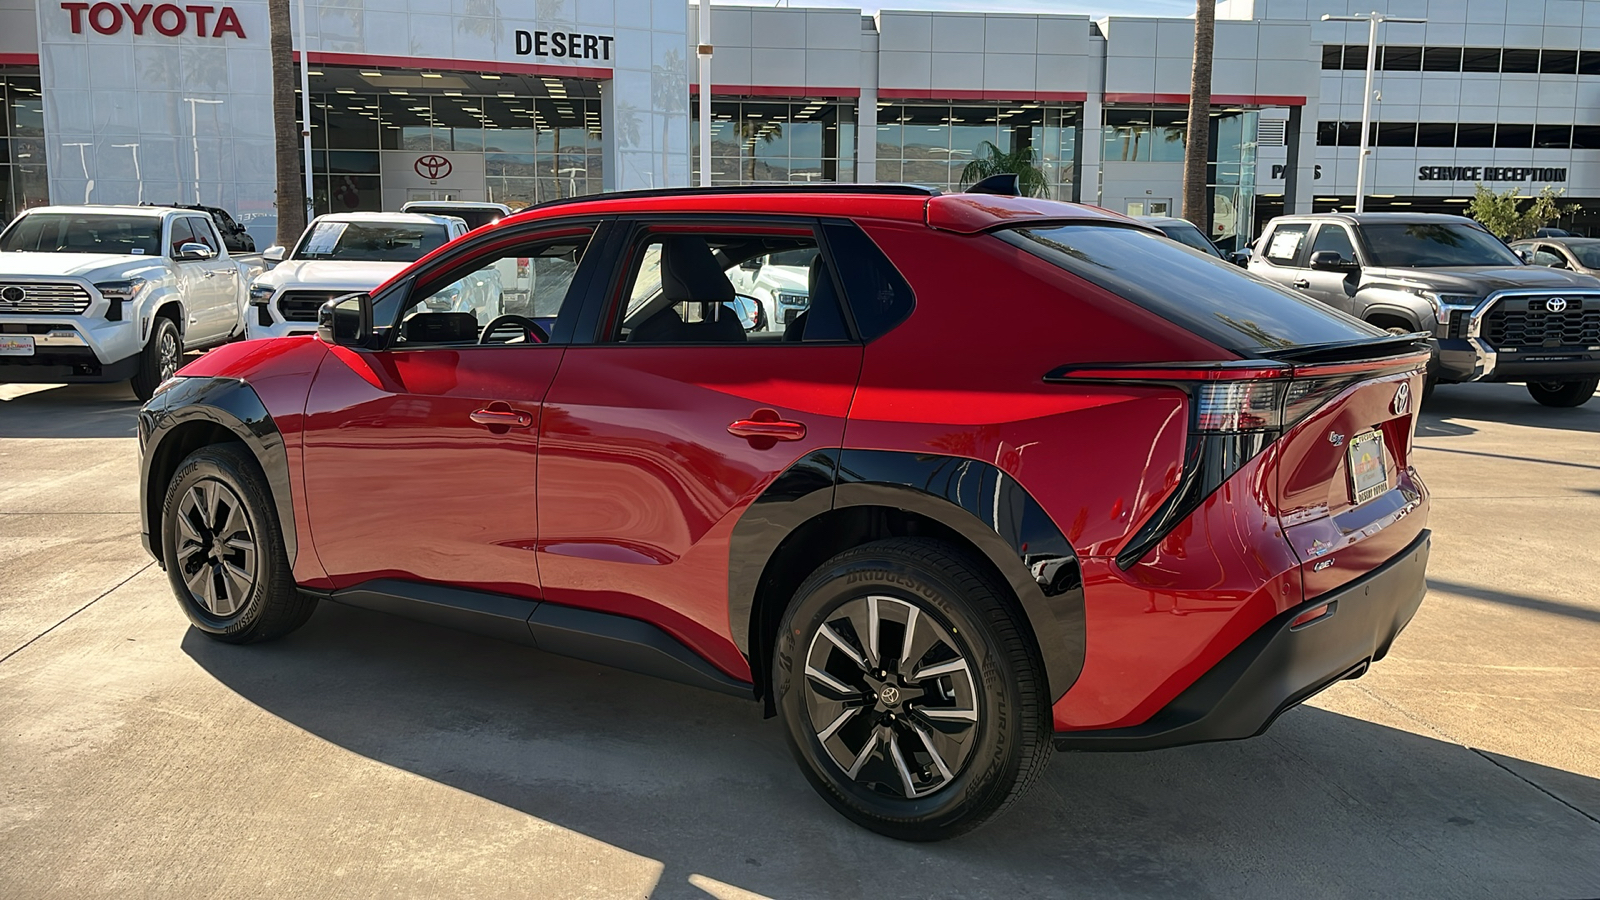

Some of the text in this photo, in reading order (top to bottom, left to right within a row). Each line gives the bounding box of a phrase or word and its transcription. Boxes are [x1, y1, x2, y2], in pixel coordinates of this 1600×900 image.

[61, 2, 247, 39] TOYOTA
[515, 30, 614, 60] DESERT
[1418, 166, 1567, 182] SERVICE RECEPTION
[845, 569, 954, 614] BRIDGESTONE
